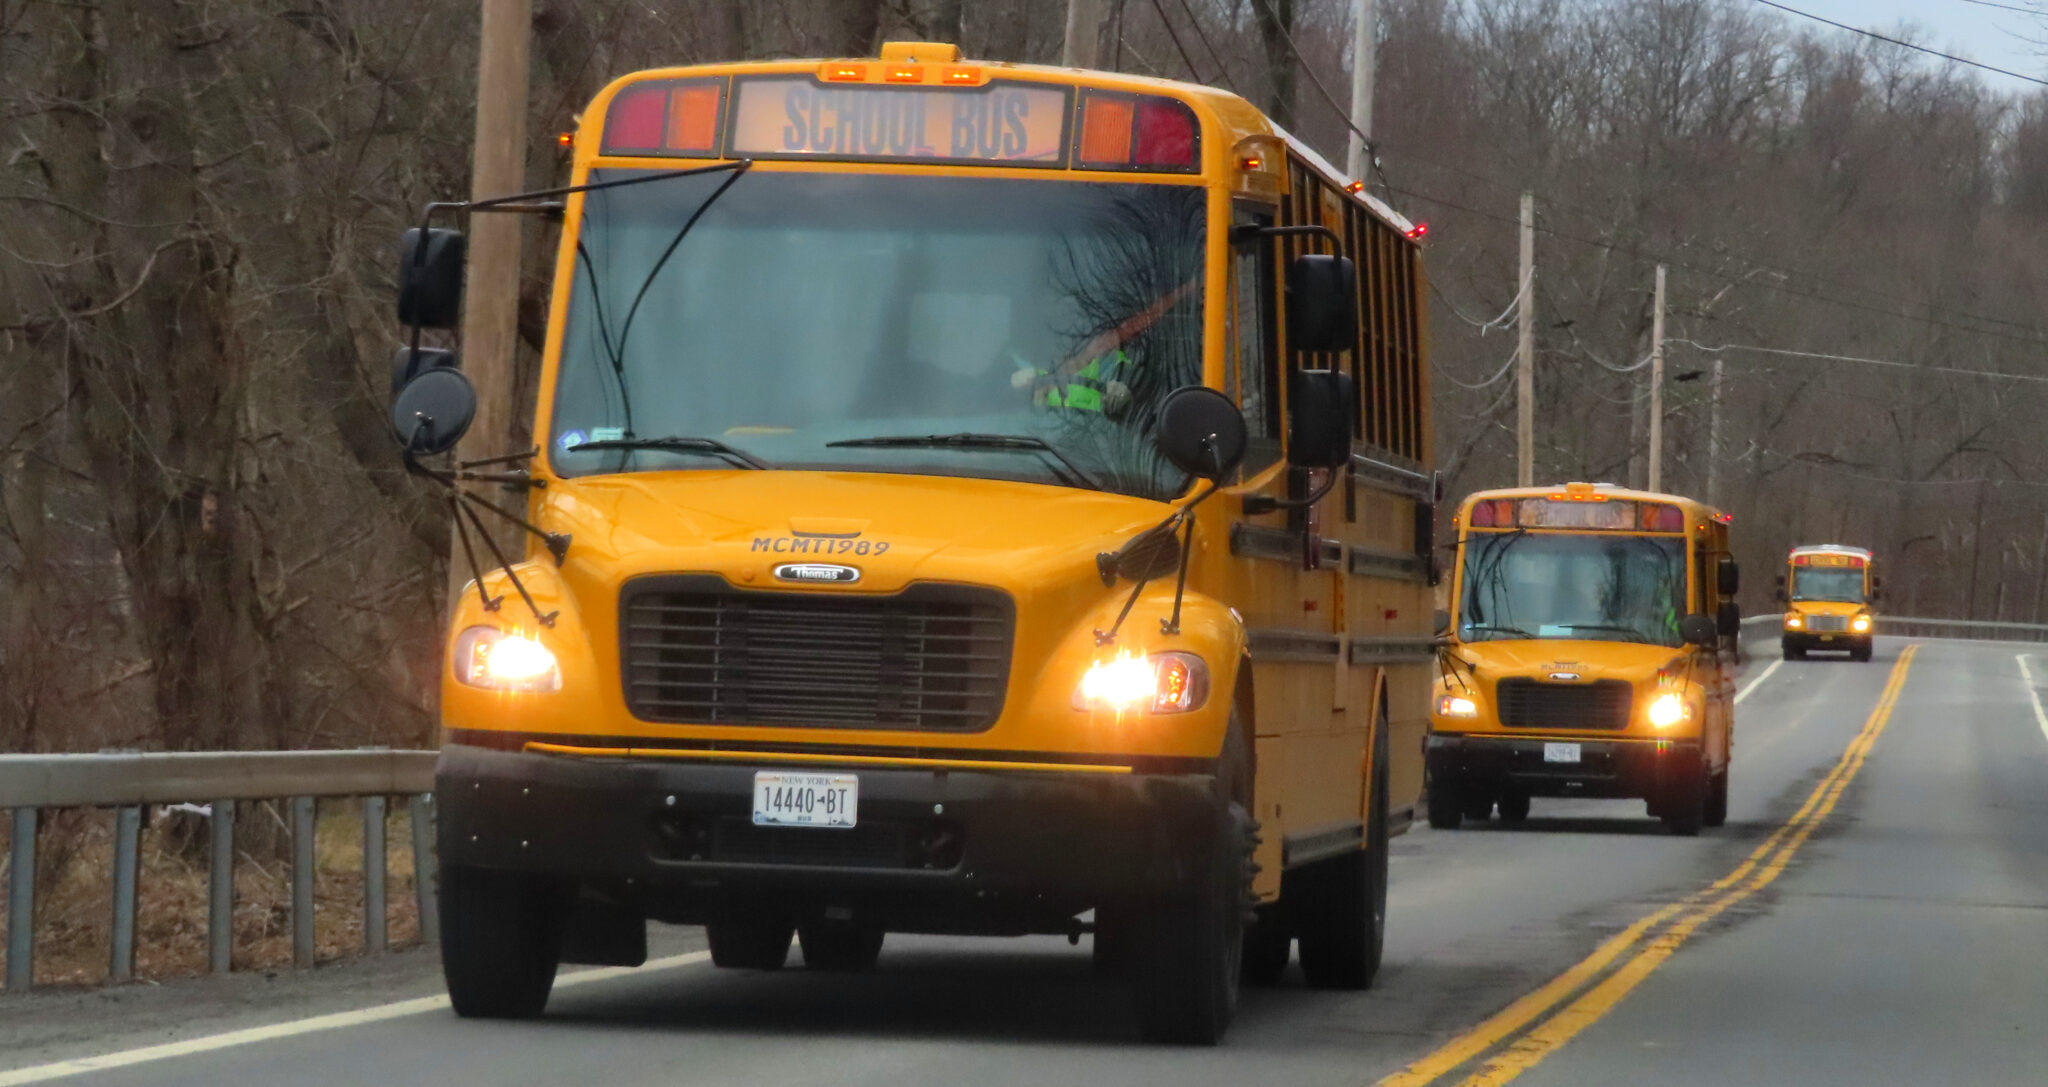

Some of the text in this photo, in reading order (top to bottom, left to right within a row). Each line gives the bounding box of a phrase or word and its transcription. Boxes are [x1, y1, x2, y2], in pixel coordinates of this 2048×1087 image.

[784, 87, 1029, 159] SCHOOL BUS
[791, 566, 843, 580] Thomas
[781, 775, 831, 785] NEW YORK
